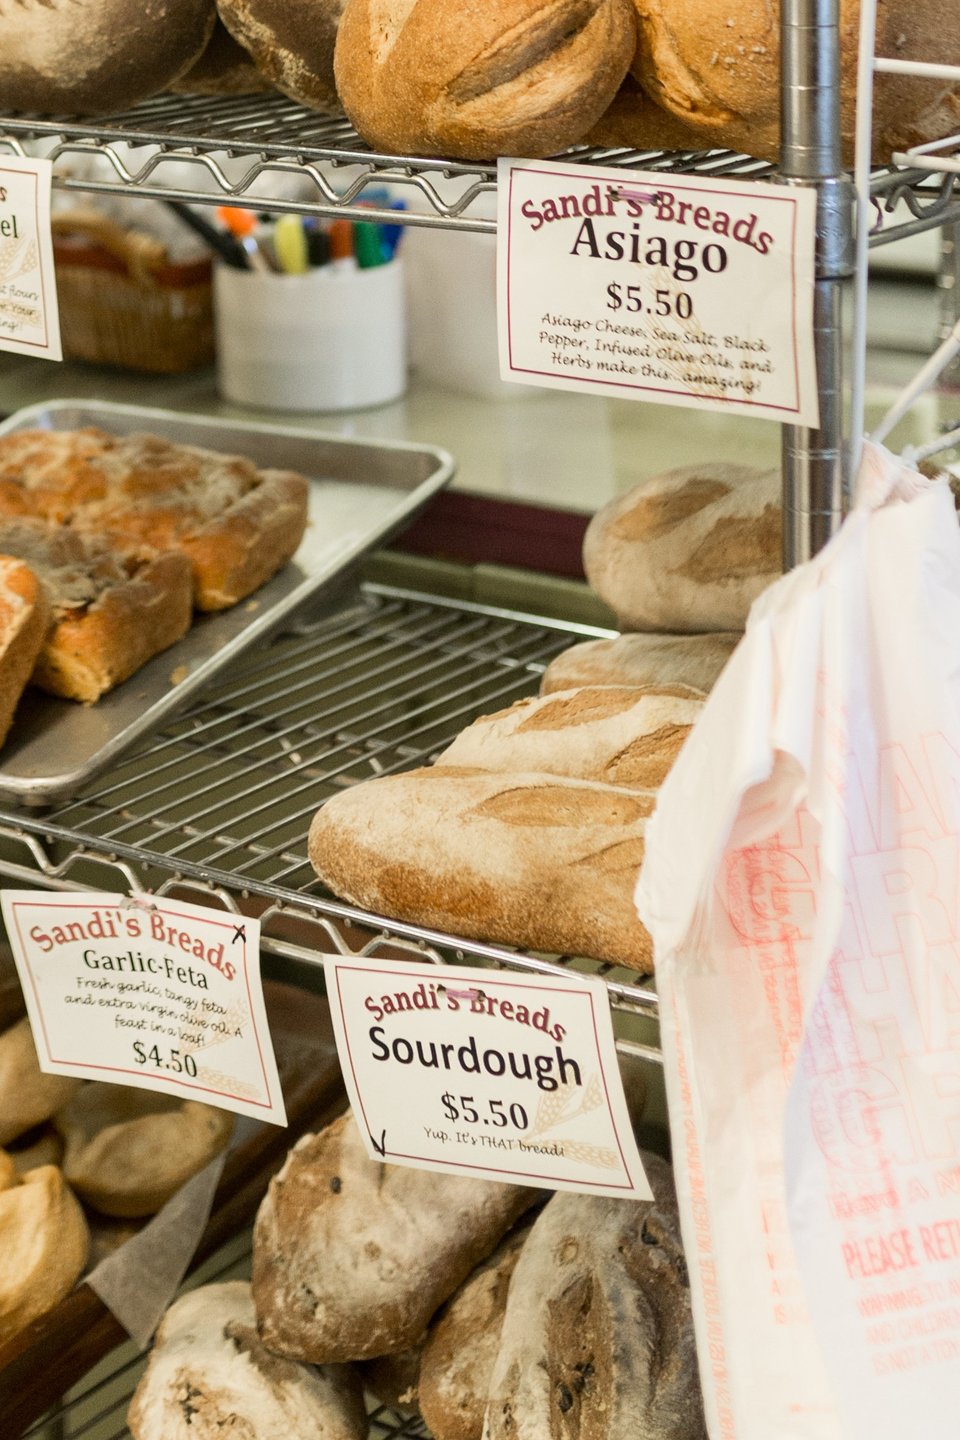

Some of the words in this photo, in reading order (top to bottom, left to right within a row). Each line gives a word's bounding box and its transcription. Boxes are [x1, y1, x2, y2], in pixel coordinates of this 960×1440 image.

[521, 184, 644, 231] Sandi's
[655, 191, 775, 256] Breads
[570, 217, 727, 282] Asiago
[607, 280, 693, 320] $5.50
[539, 331, 589, 350] Pepper,
[594, 339, 652, 358] Infused
[739, 358, 775, 374] and
[541, 312, 592, 330] Asiago
[652, 328, 679, 342] Sea
[724, 335, 770, 353] Black
[551, 351, 593, 369] Herbs
[596, 359, 639, 375] make
[30, 910, 141, 953] Sandi's
[150, 910, 237, 982] Breads
[83, 949, 209, 991] Garlic-Feta
[64, 993, 96, 1006] and
[98, 996, 137, 1010] extra
[179, 1013, 209, 1029] olive
[76, 976, 115, 990] Fresh
[117, 980, 163, 998] garlic,
[165, 987, 199, 1010] tangy
[201, 998, 228, 1015] feta
[365, 983, 461, 1022] Sandi's
[469, 988, 567, 1043] Breads
[115, 1014, 148, 1029] feast
[133, 1039, 197, 1078] $4.50
[369, 1026, 582, 1092] Sourdough
[441, 1091, 529, 1130] $5.50
[424, 1126, 452, 1144] Yup.
[456, 1131, 478, 1146] It's
[480, 1134, 514, 1151] THAT
[841, 1226, 919, 1279] PLEASE
